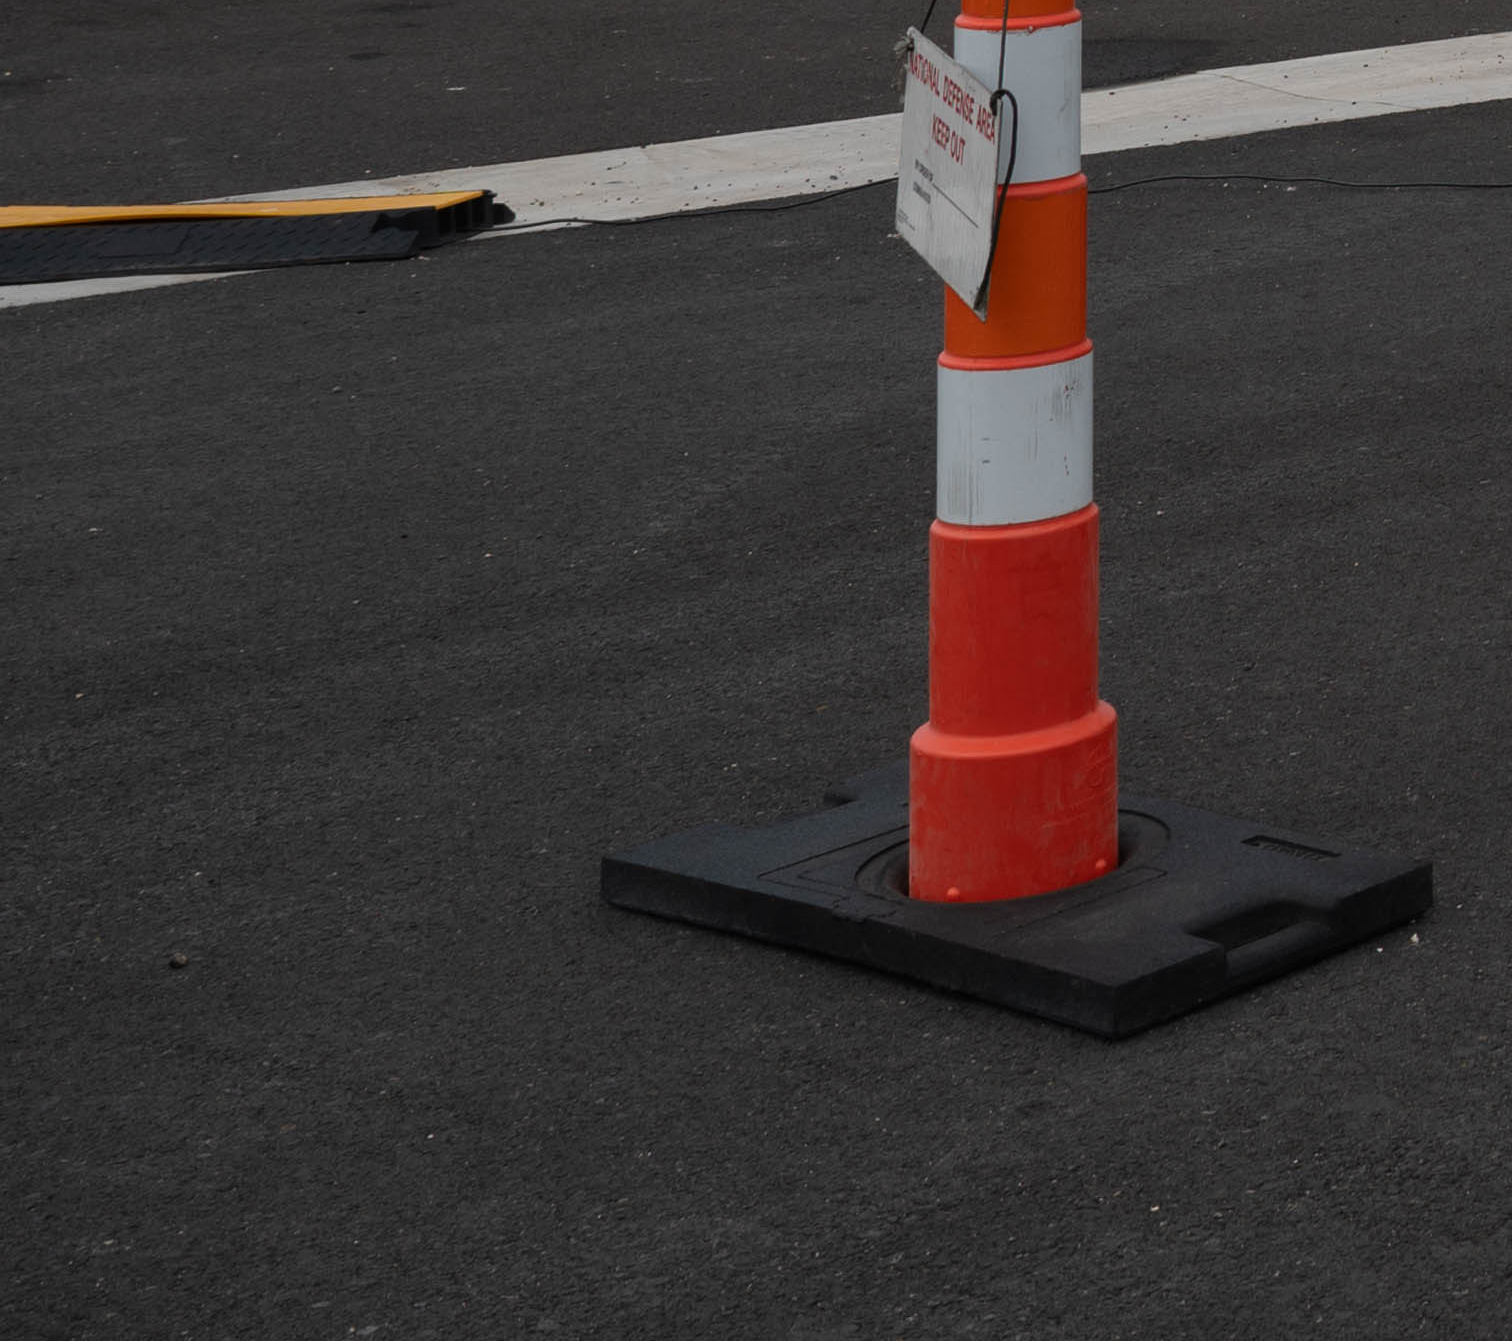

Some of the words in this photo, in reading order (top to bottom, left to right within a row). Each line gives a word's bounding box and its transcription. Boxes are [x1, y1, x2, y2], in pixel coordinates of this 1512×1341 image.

[909, 52, 941, 98] NATIONAL
[942, 74, 975, 125] DEFENSE
[976, 103, 996, 145] AREA
[932, 112, 951, 151] KEEP
[950, 130, 966, 166] OUT
